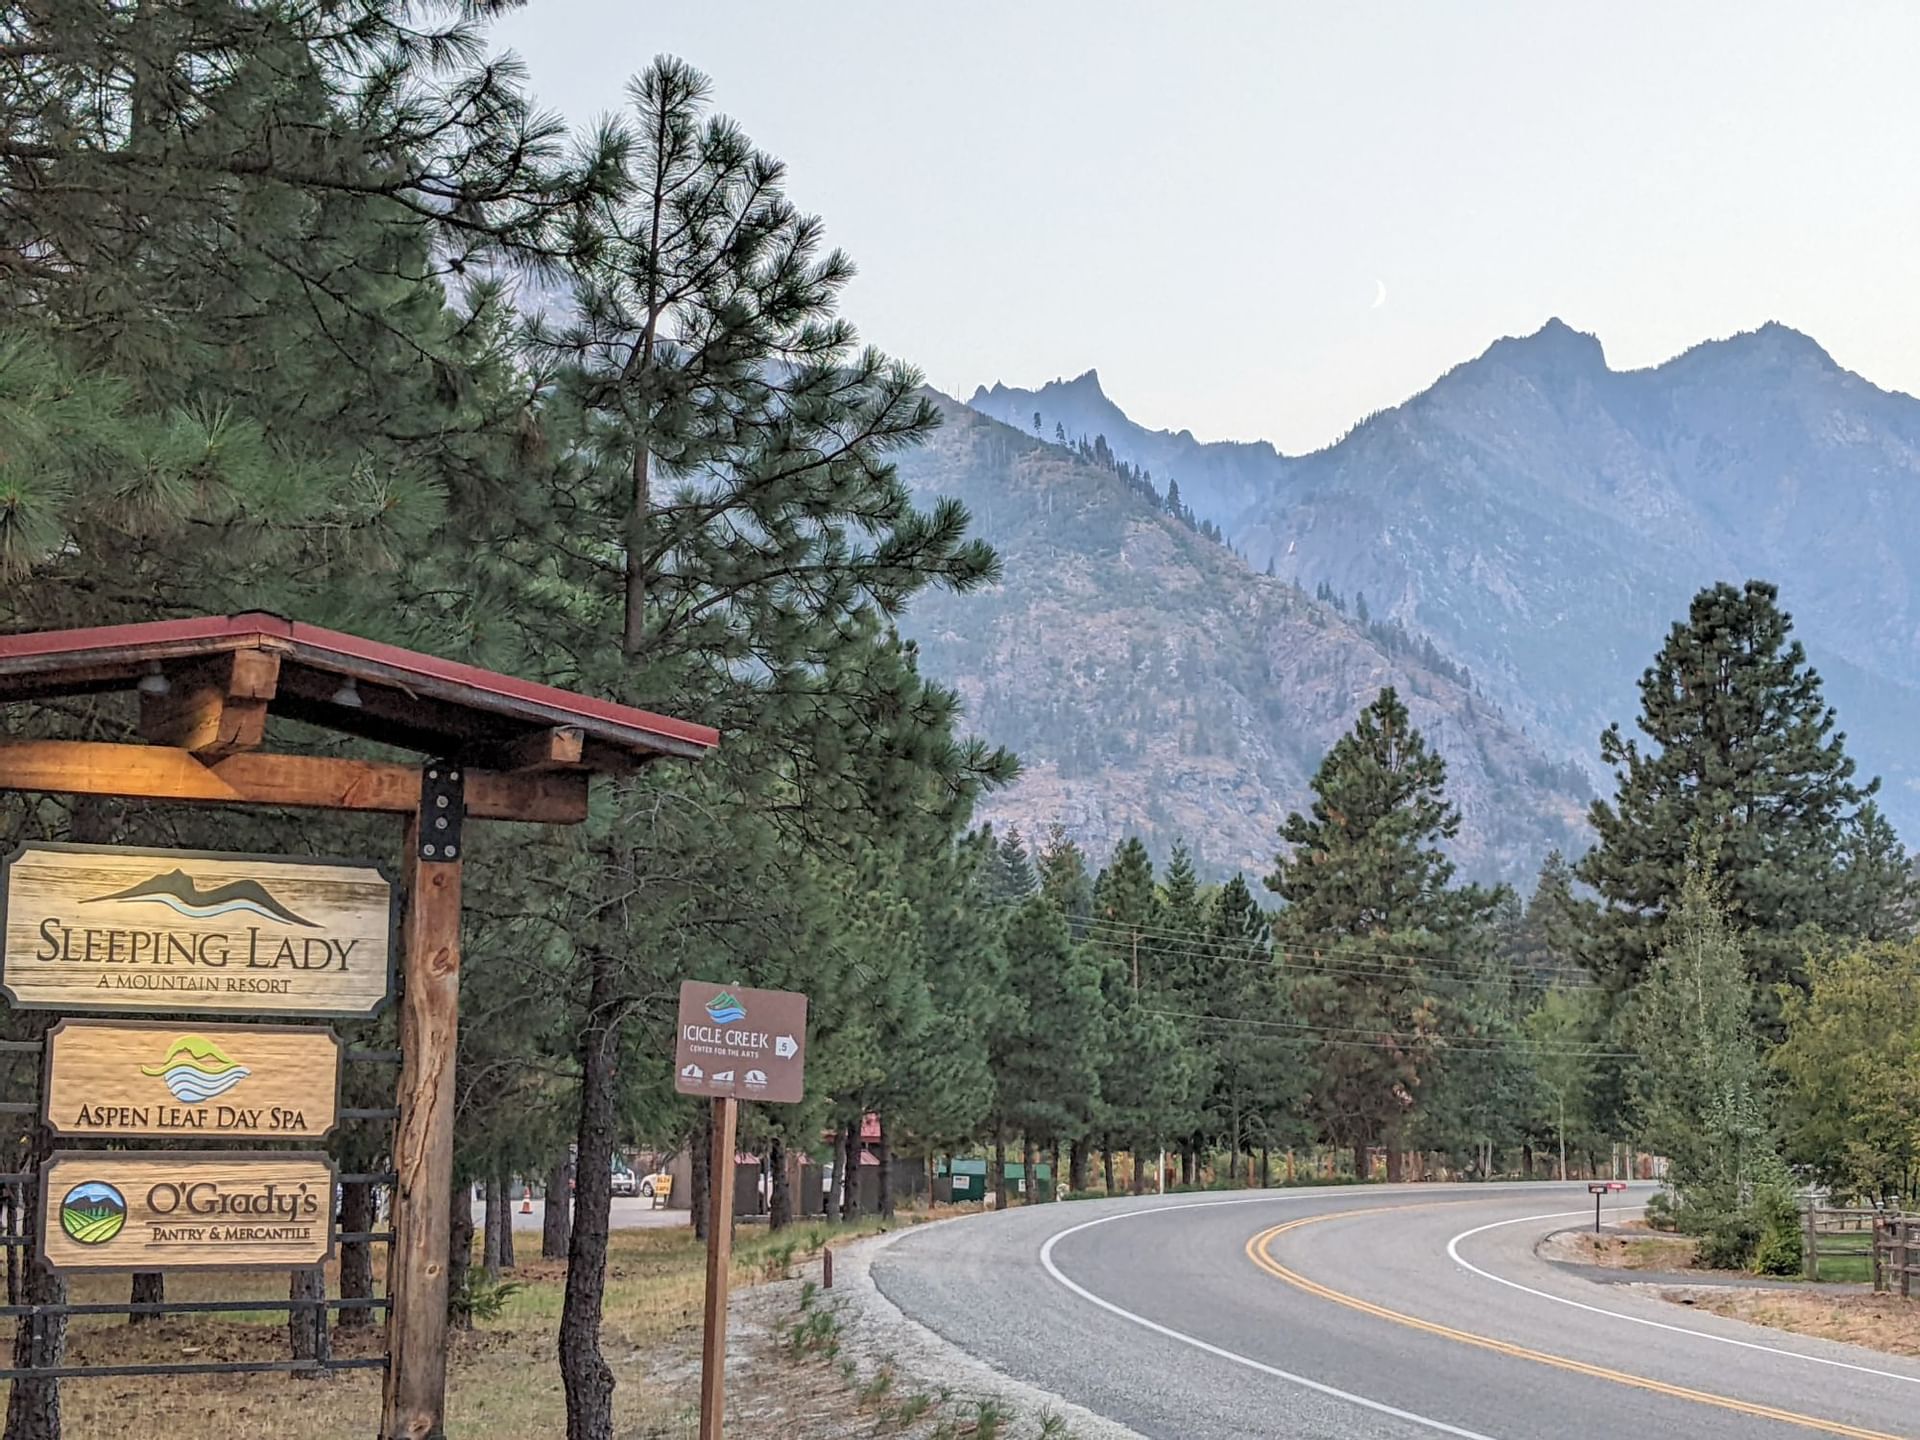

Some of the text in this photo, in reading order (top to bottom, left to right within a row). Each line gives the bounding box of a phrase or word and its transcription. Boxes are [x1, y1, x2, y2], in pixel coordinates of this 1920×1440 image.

[37, 918, 358, 970] SLEEPING LADY
[96, 974, 291, 994] A MOUNTAIN RESORT
[683, 1024, 768, 1049] ICICLE CREEK
[690, 1044, 759, 1059] CENTER FOR THE ARTS
[75, 1104, 308, 1130] ASPEN LEAF DAY SPA
[147, 1181, 318, 1223] O'Grady's
[152, 1226, 311, 1241] PANTRY & MERCANTILE
